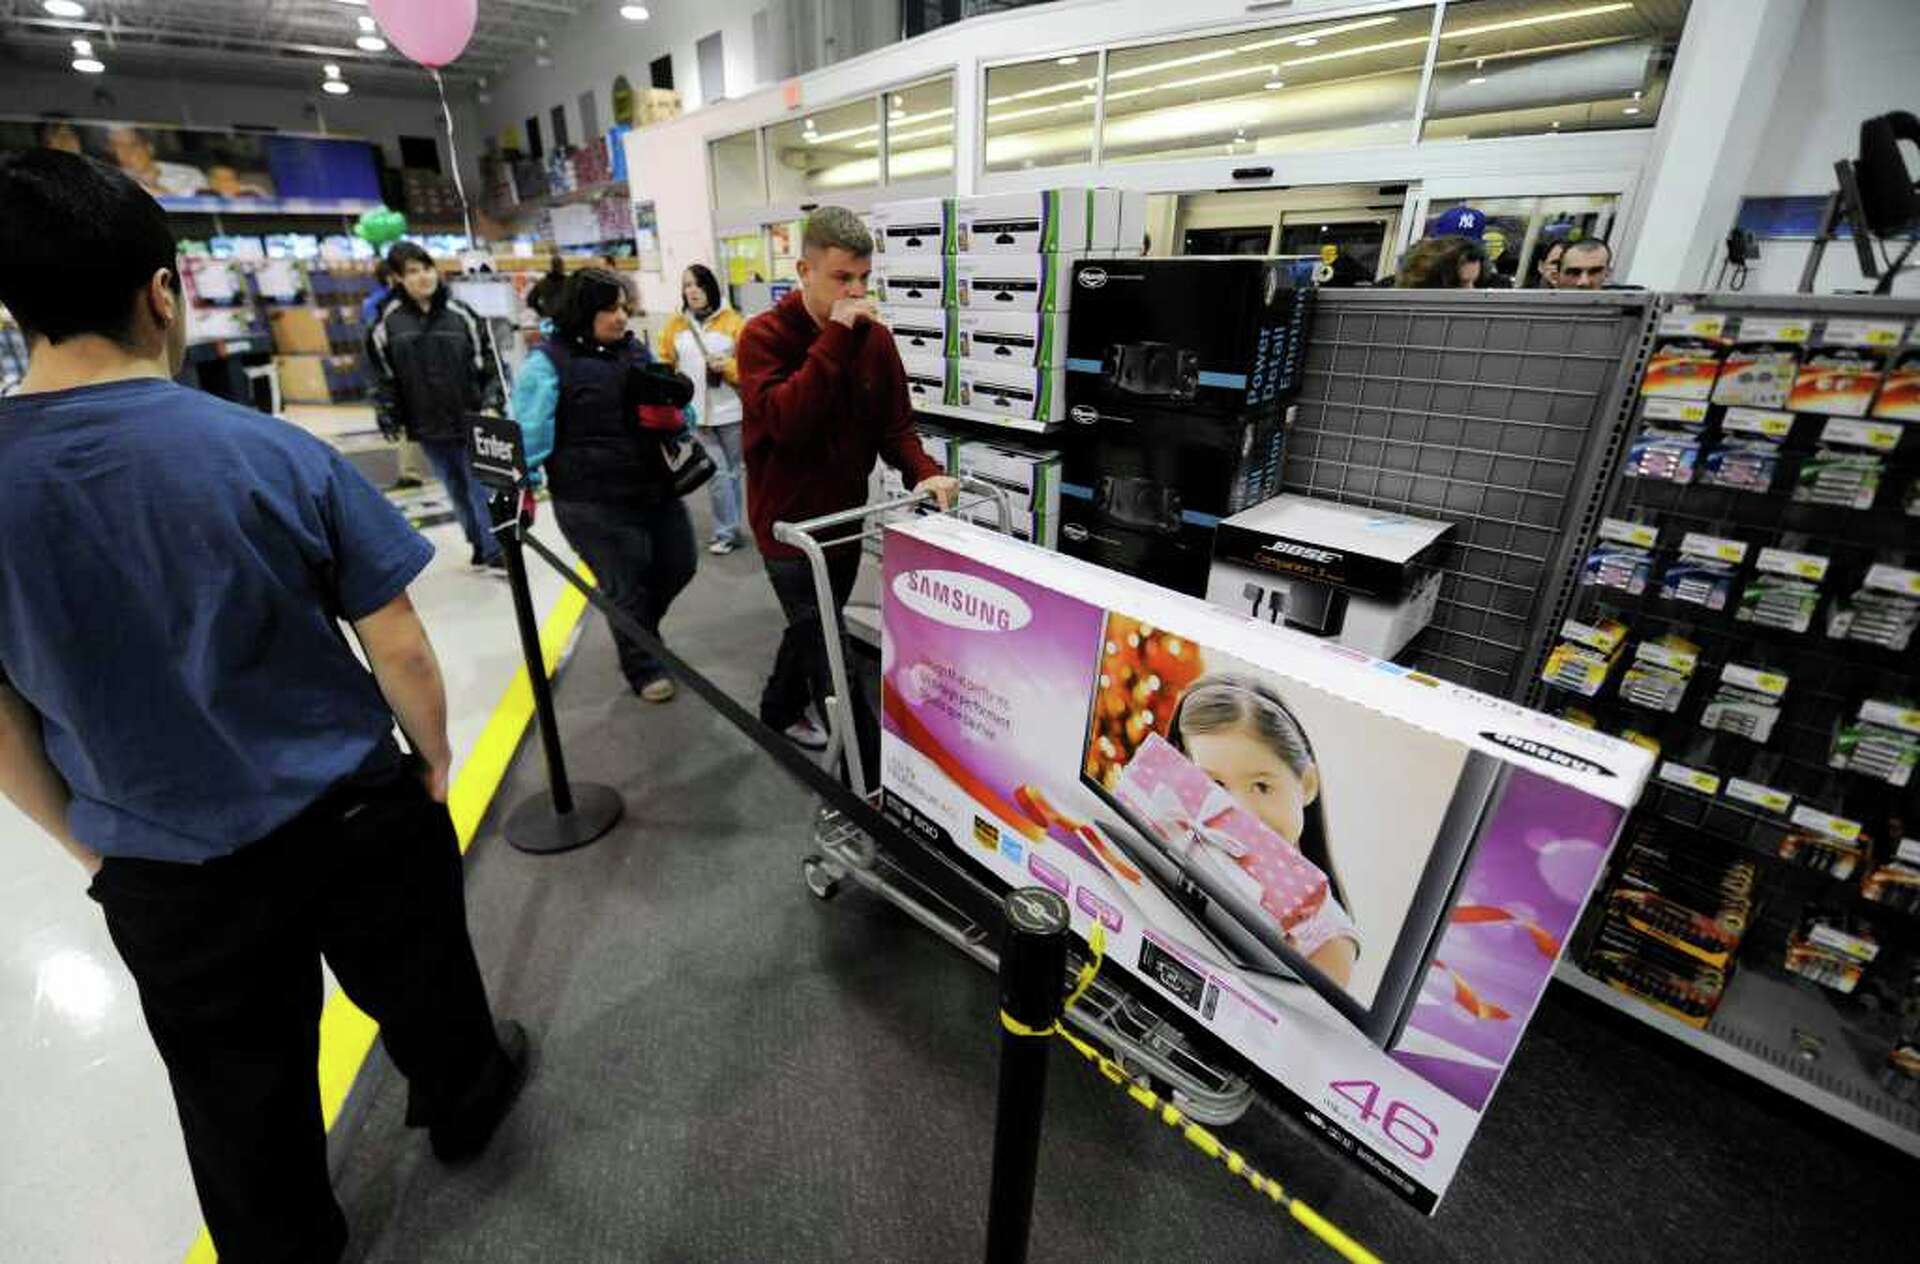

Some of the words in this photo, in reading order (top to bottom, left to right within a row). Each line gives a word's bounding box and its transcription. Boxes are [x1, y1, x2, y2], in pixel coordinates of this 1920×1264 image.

[1246, 326, 1271, 405] Power
[1262, 327, 1287, 402] Detail
[473, 426, 515, 463] Enter
[1262, 541, 1344, 565] BOSE
[907, 570, 1012, 630] SAMSUNG
[1329, 1080, 1439, 1159] 46
